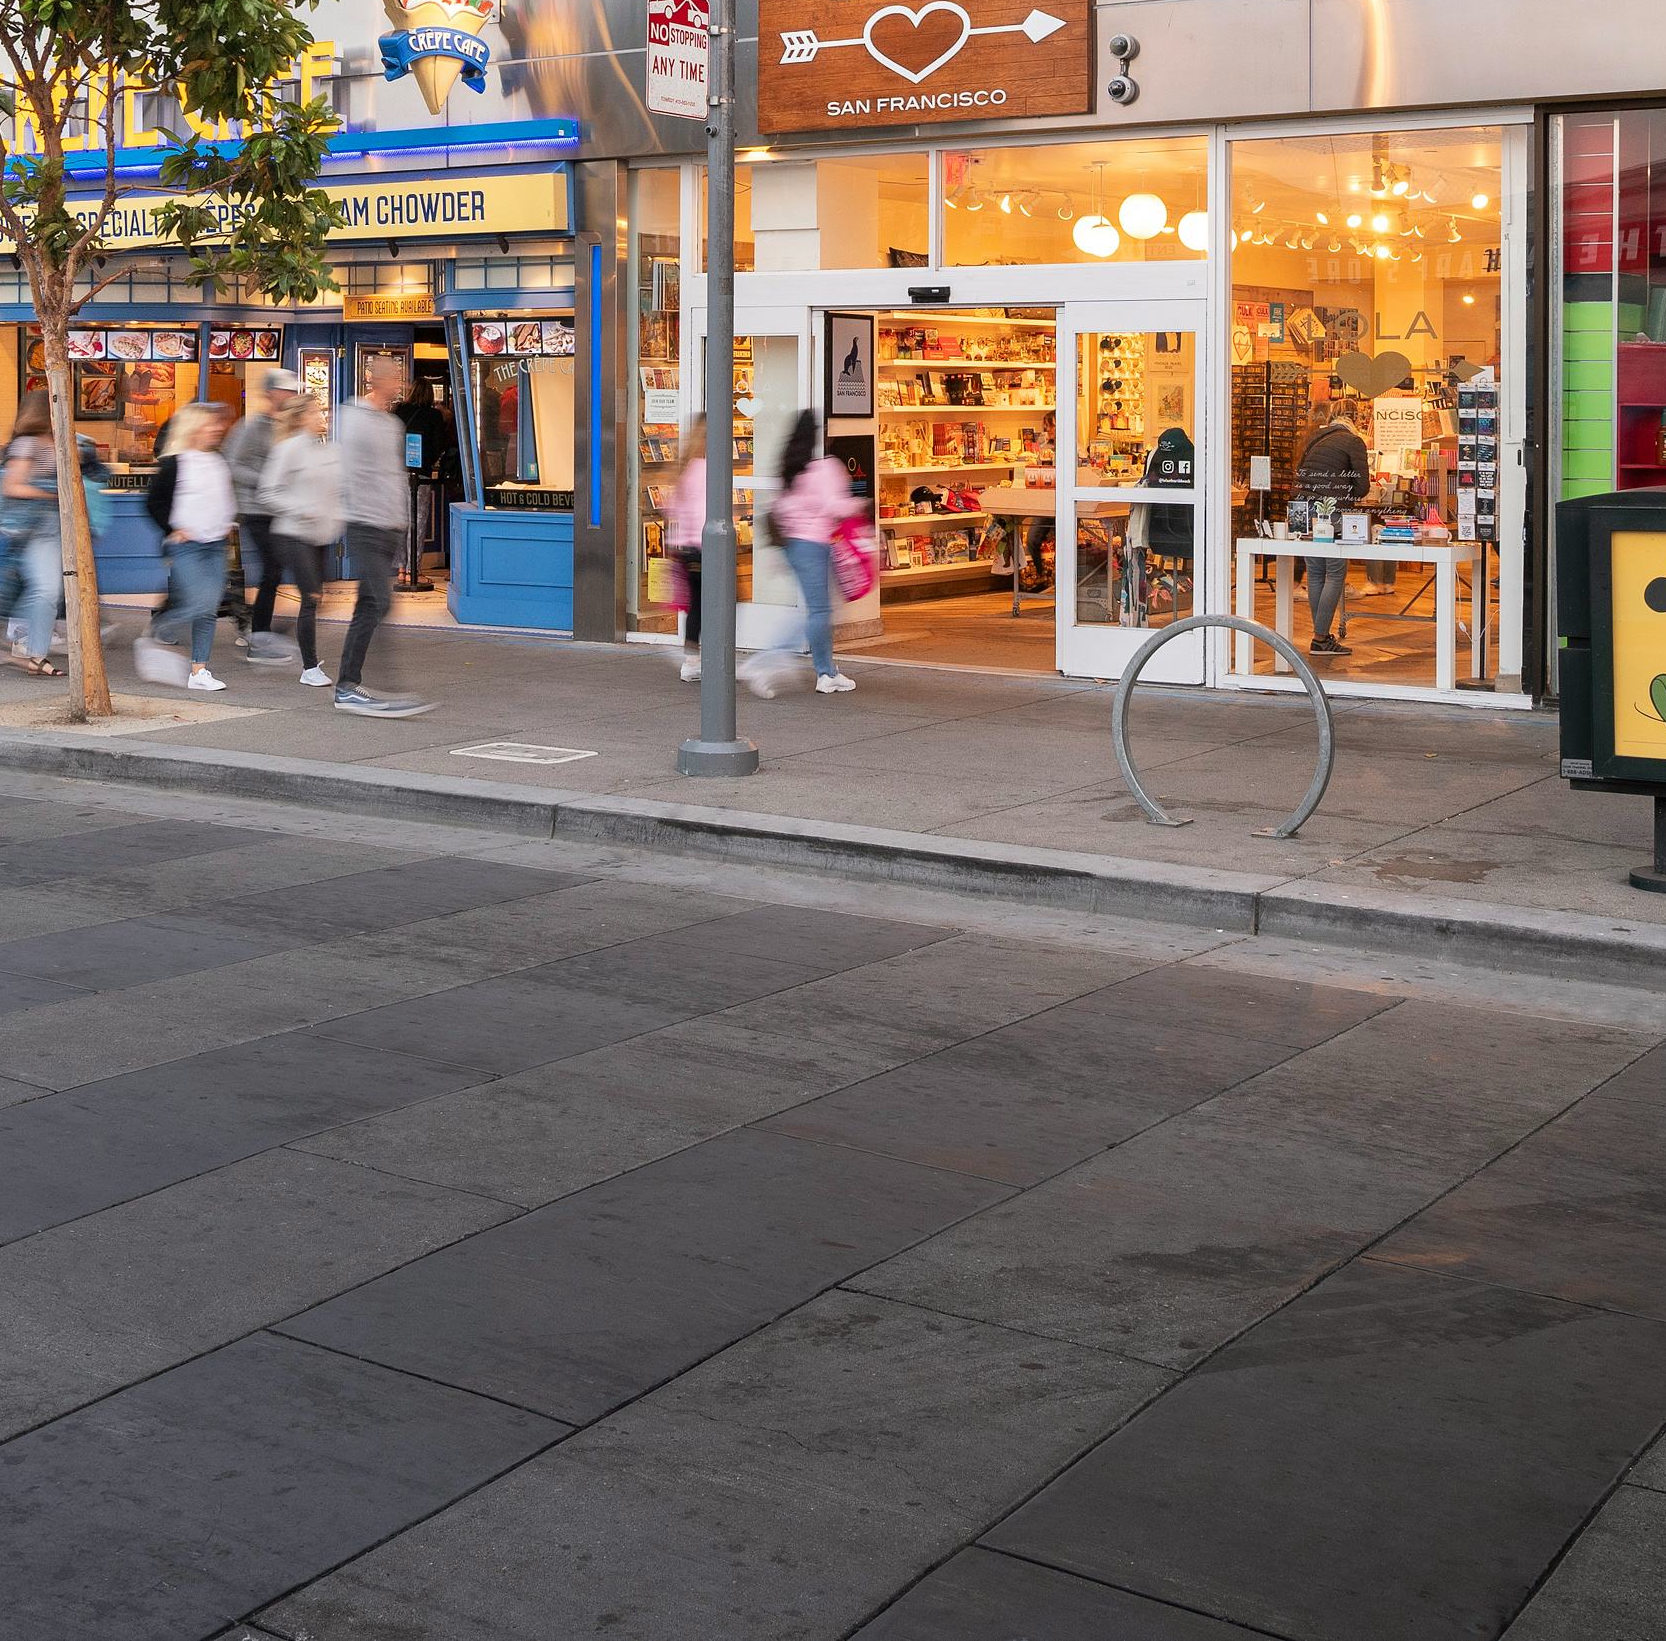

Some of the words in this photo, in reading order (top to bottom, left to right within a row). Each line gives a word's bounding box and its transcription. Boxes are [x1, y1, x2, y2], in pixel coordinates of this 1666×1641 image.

[408, 29, 451, 52] CRÊPE
[651, 22, 669, 42] NO
[670, 28, 707, 50] STOPPING
[653, 55, 675, 77] ANY
[680, 60, 705, 83] TIME
[827, 99, 870, 116] SAN
[877, 89, 1007, 112] FRANCISCO
[376, 190, 485, 225] CHOWDER
[357, 301, 373, 315] PATIO
[374, 300, 399, 315] SEATING
[400, 299, 432, 314] AVAILABLE
[1307, 311, 1438, 340] LOLA
[494, 362, 518, 382] THE
[519, 354, 556, 374] CRÊPE
[107, 476, 152, 487] NUTELLA
[1296, 469, 1307, 478] To
[1309, 470, 1331, 478] send
[1340, 469, 1361, 478] letter
[500, 492, 517, 504] HOT
[526, 493, 549, 505] COLD
[1312, 482, 1331, 492] good
[1333, 484, 1354, 492] way
[1365, 507, 1407, 516] anything
